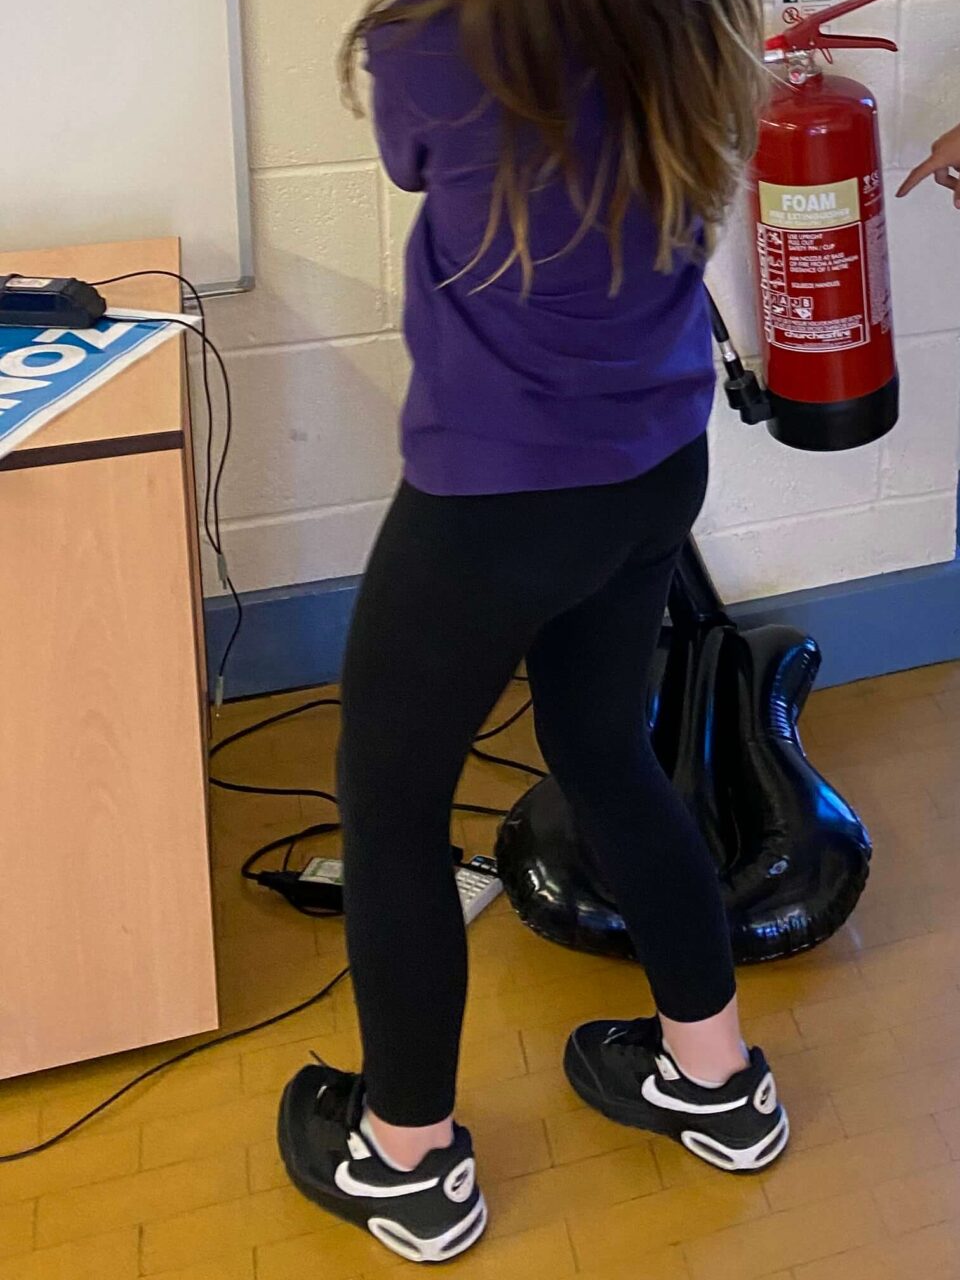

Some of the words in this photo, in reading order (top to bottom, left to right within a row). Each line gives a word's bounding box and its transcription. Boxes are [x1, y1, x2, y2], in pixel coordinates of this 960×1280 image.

[781, 191, 837, 212] FOAM
[780, 296, 787, 304] A
[802, 298, 810, 307] B
[0, 321, 140, 418] ZO
